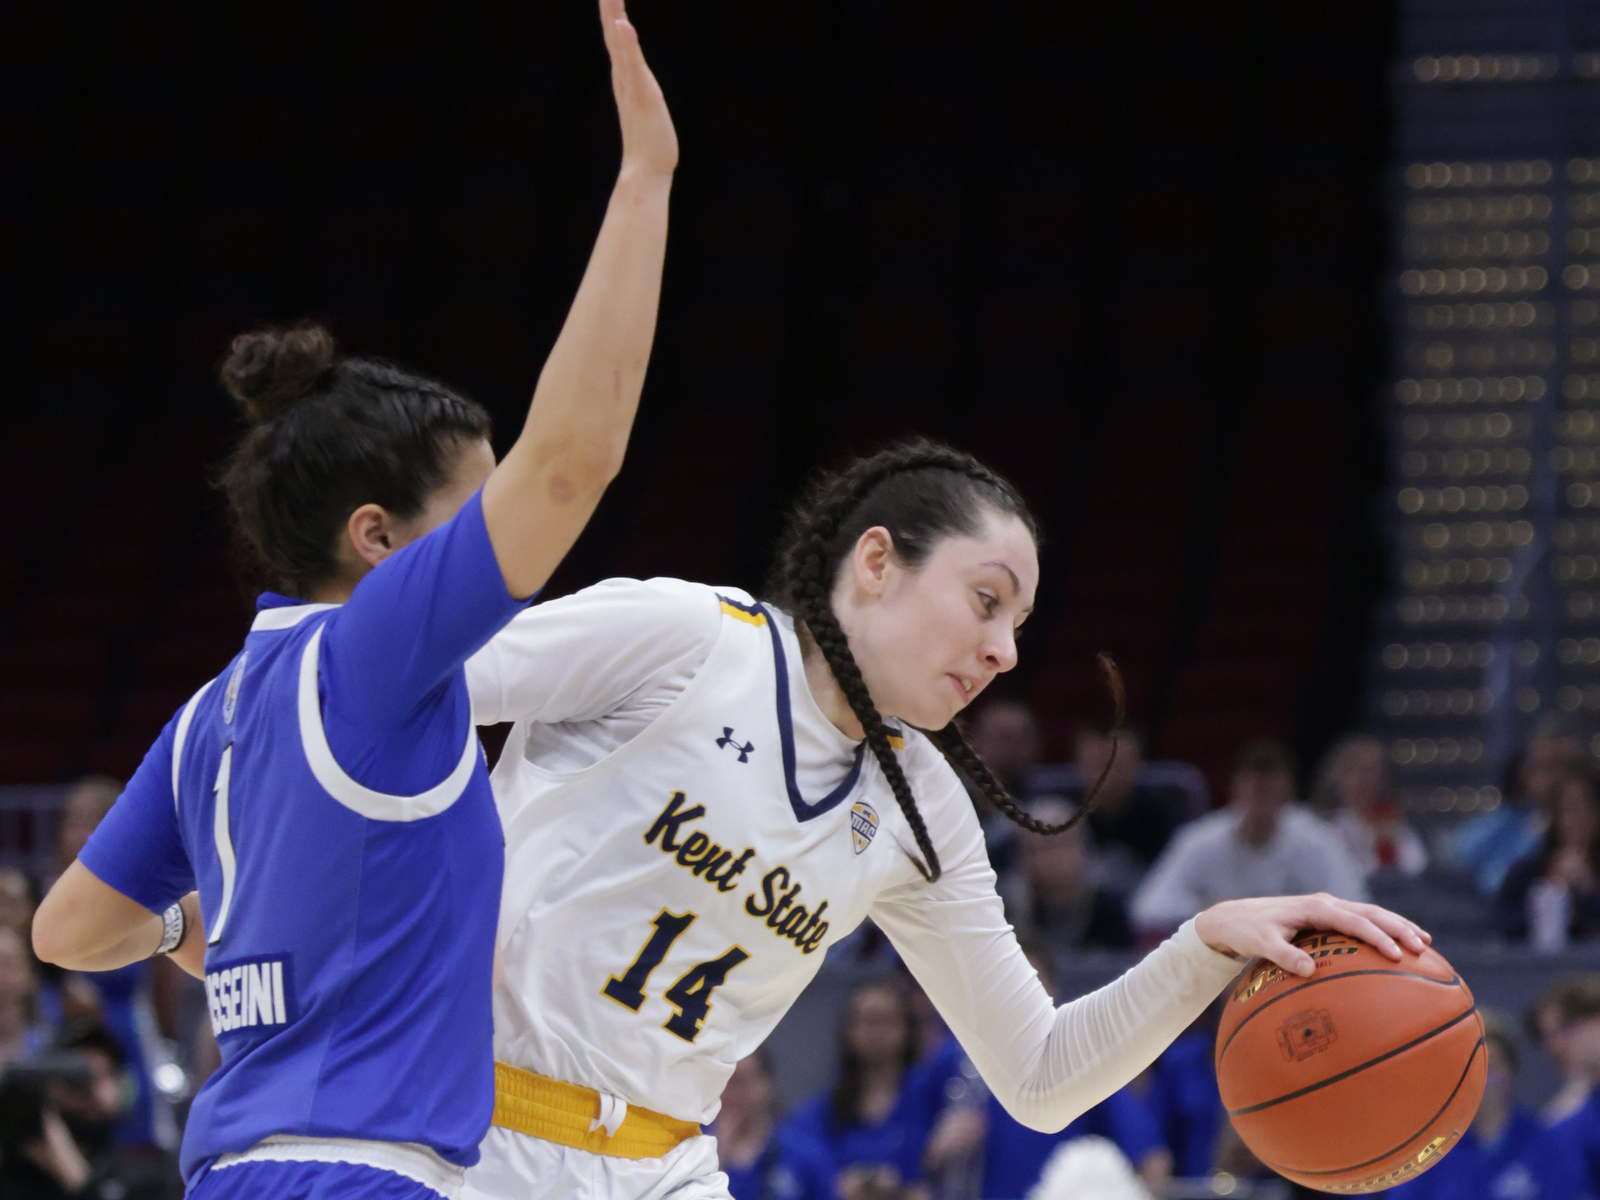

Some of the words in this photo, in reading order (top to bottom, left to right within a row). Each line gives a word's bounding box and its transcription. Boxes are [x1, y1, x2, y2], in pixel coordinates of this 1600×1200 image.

[643, 790, 755, 893] Kent
[745, 865, 829, 955] State
[852, 814, 876, 839] MAC
[600, 907, 752, 1044] 14
